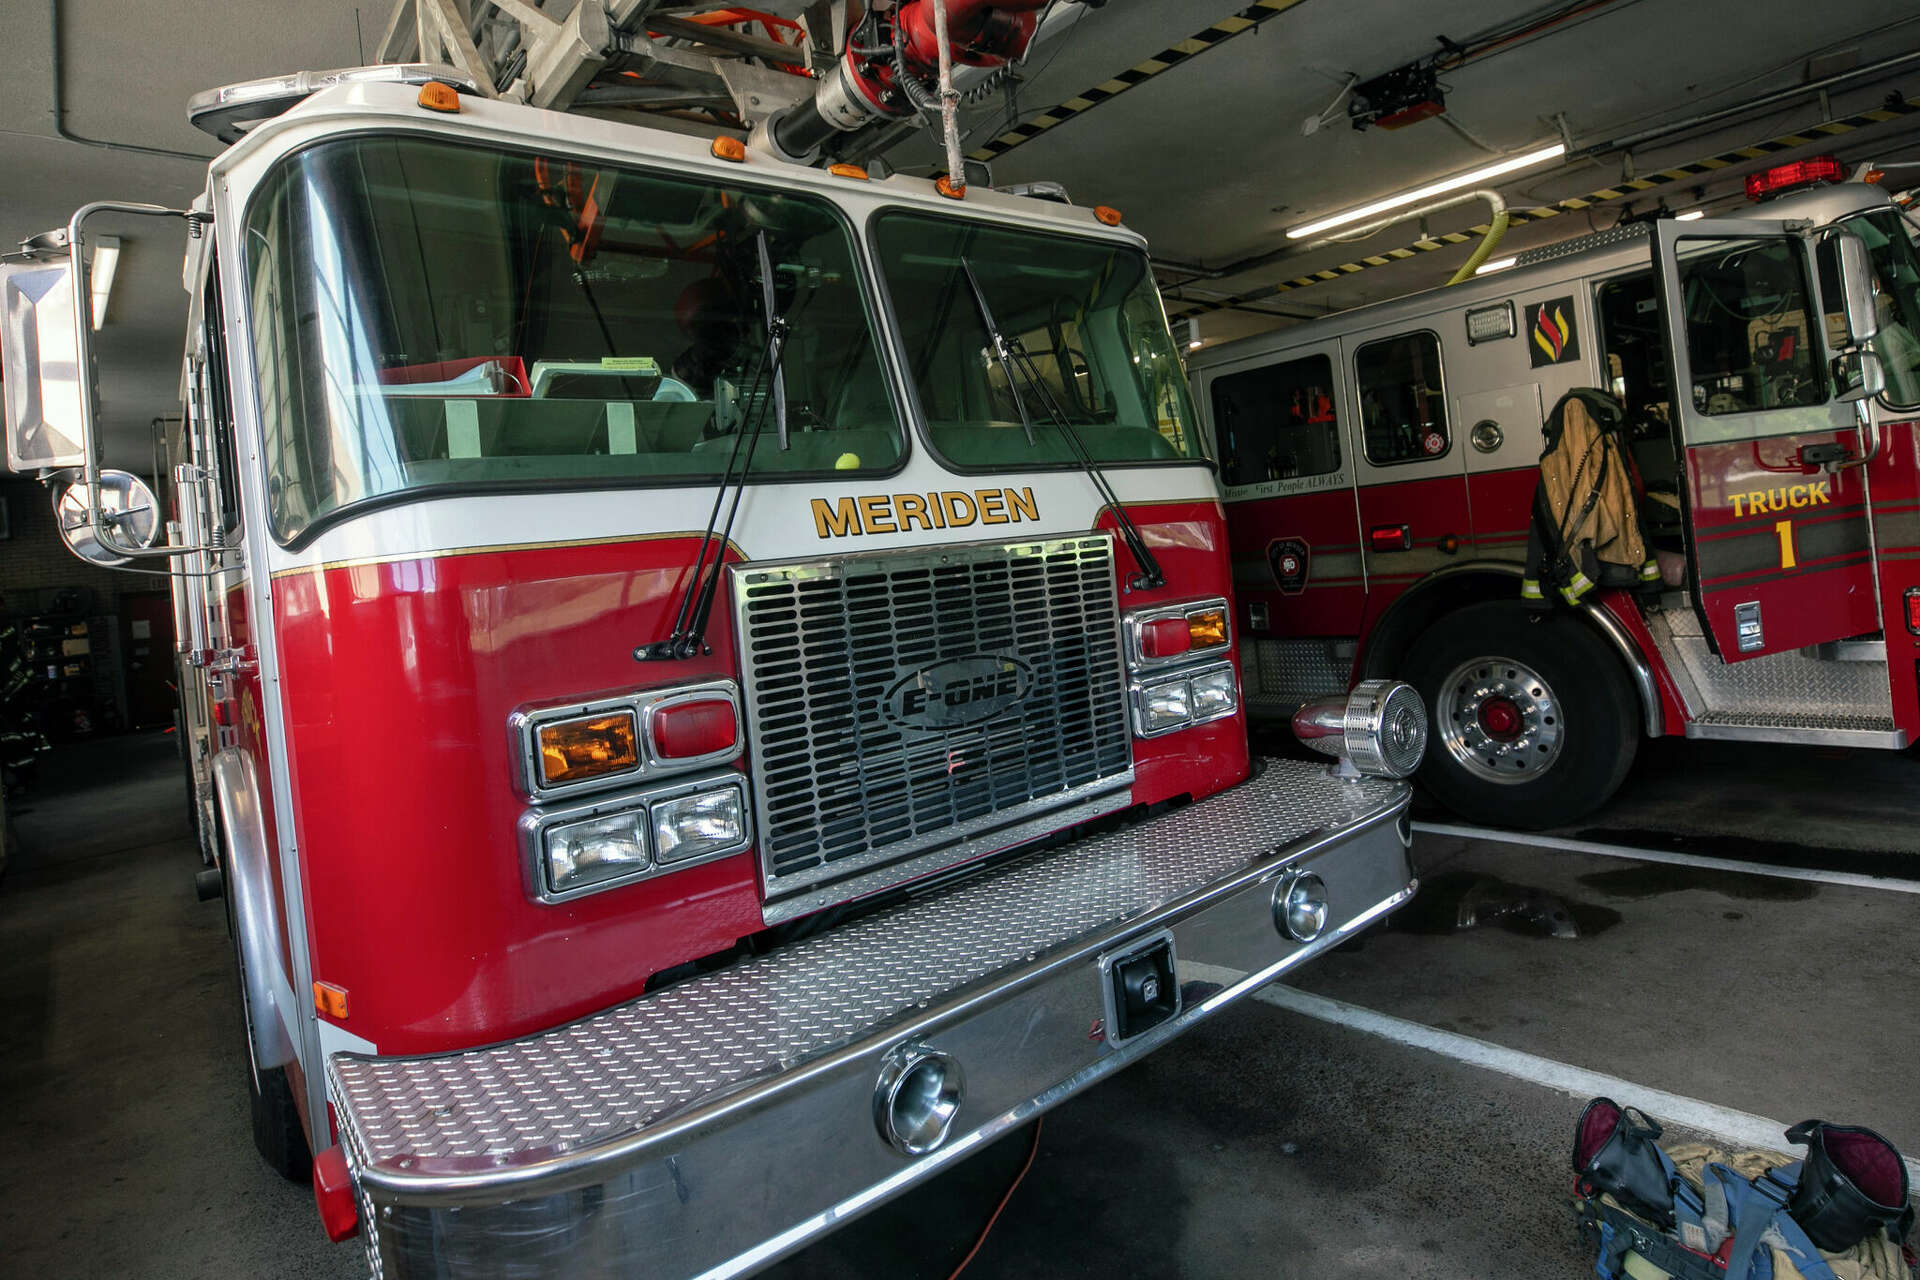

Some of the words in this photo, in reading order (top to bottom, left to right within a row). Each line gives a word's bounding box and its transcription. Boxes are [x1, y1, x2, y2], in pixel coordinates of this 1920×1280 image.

[1278, 479, 1305, 493] People
[1305, 471, 1345, 488] ALWAYS
[1728, 481, 1830, 518] TRUCK
[810, 487, 1040, 539] MERIDEN
[1775, 520, 1796, 569] 1
[902, 669, 1017, 717] E-ONE
